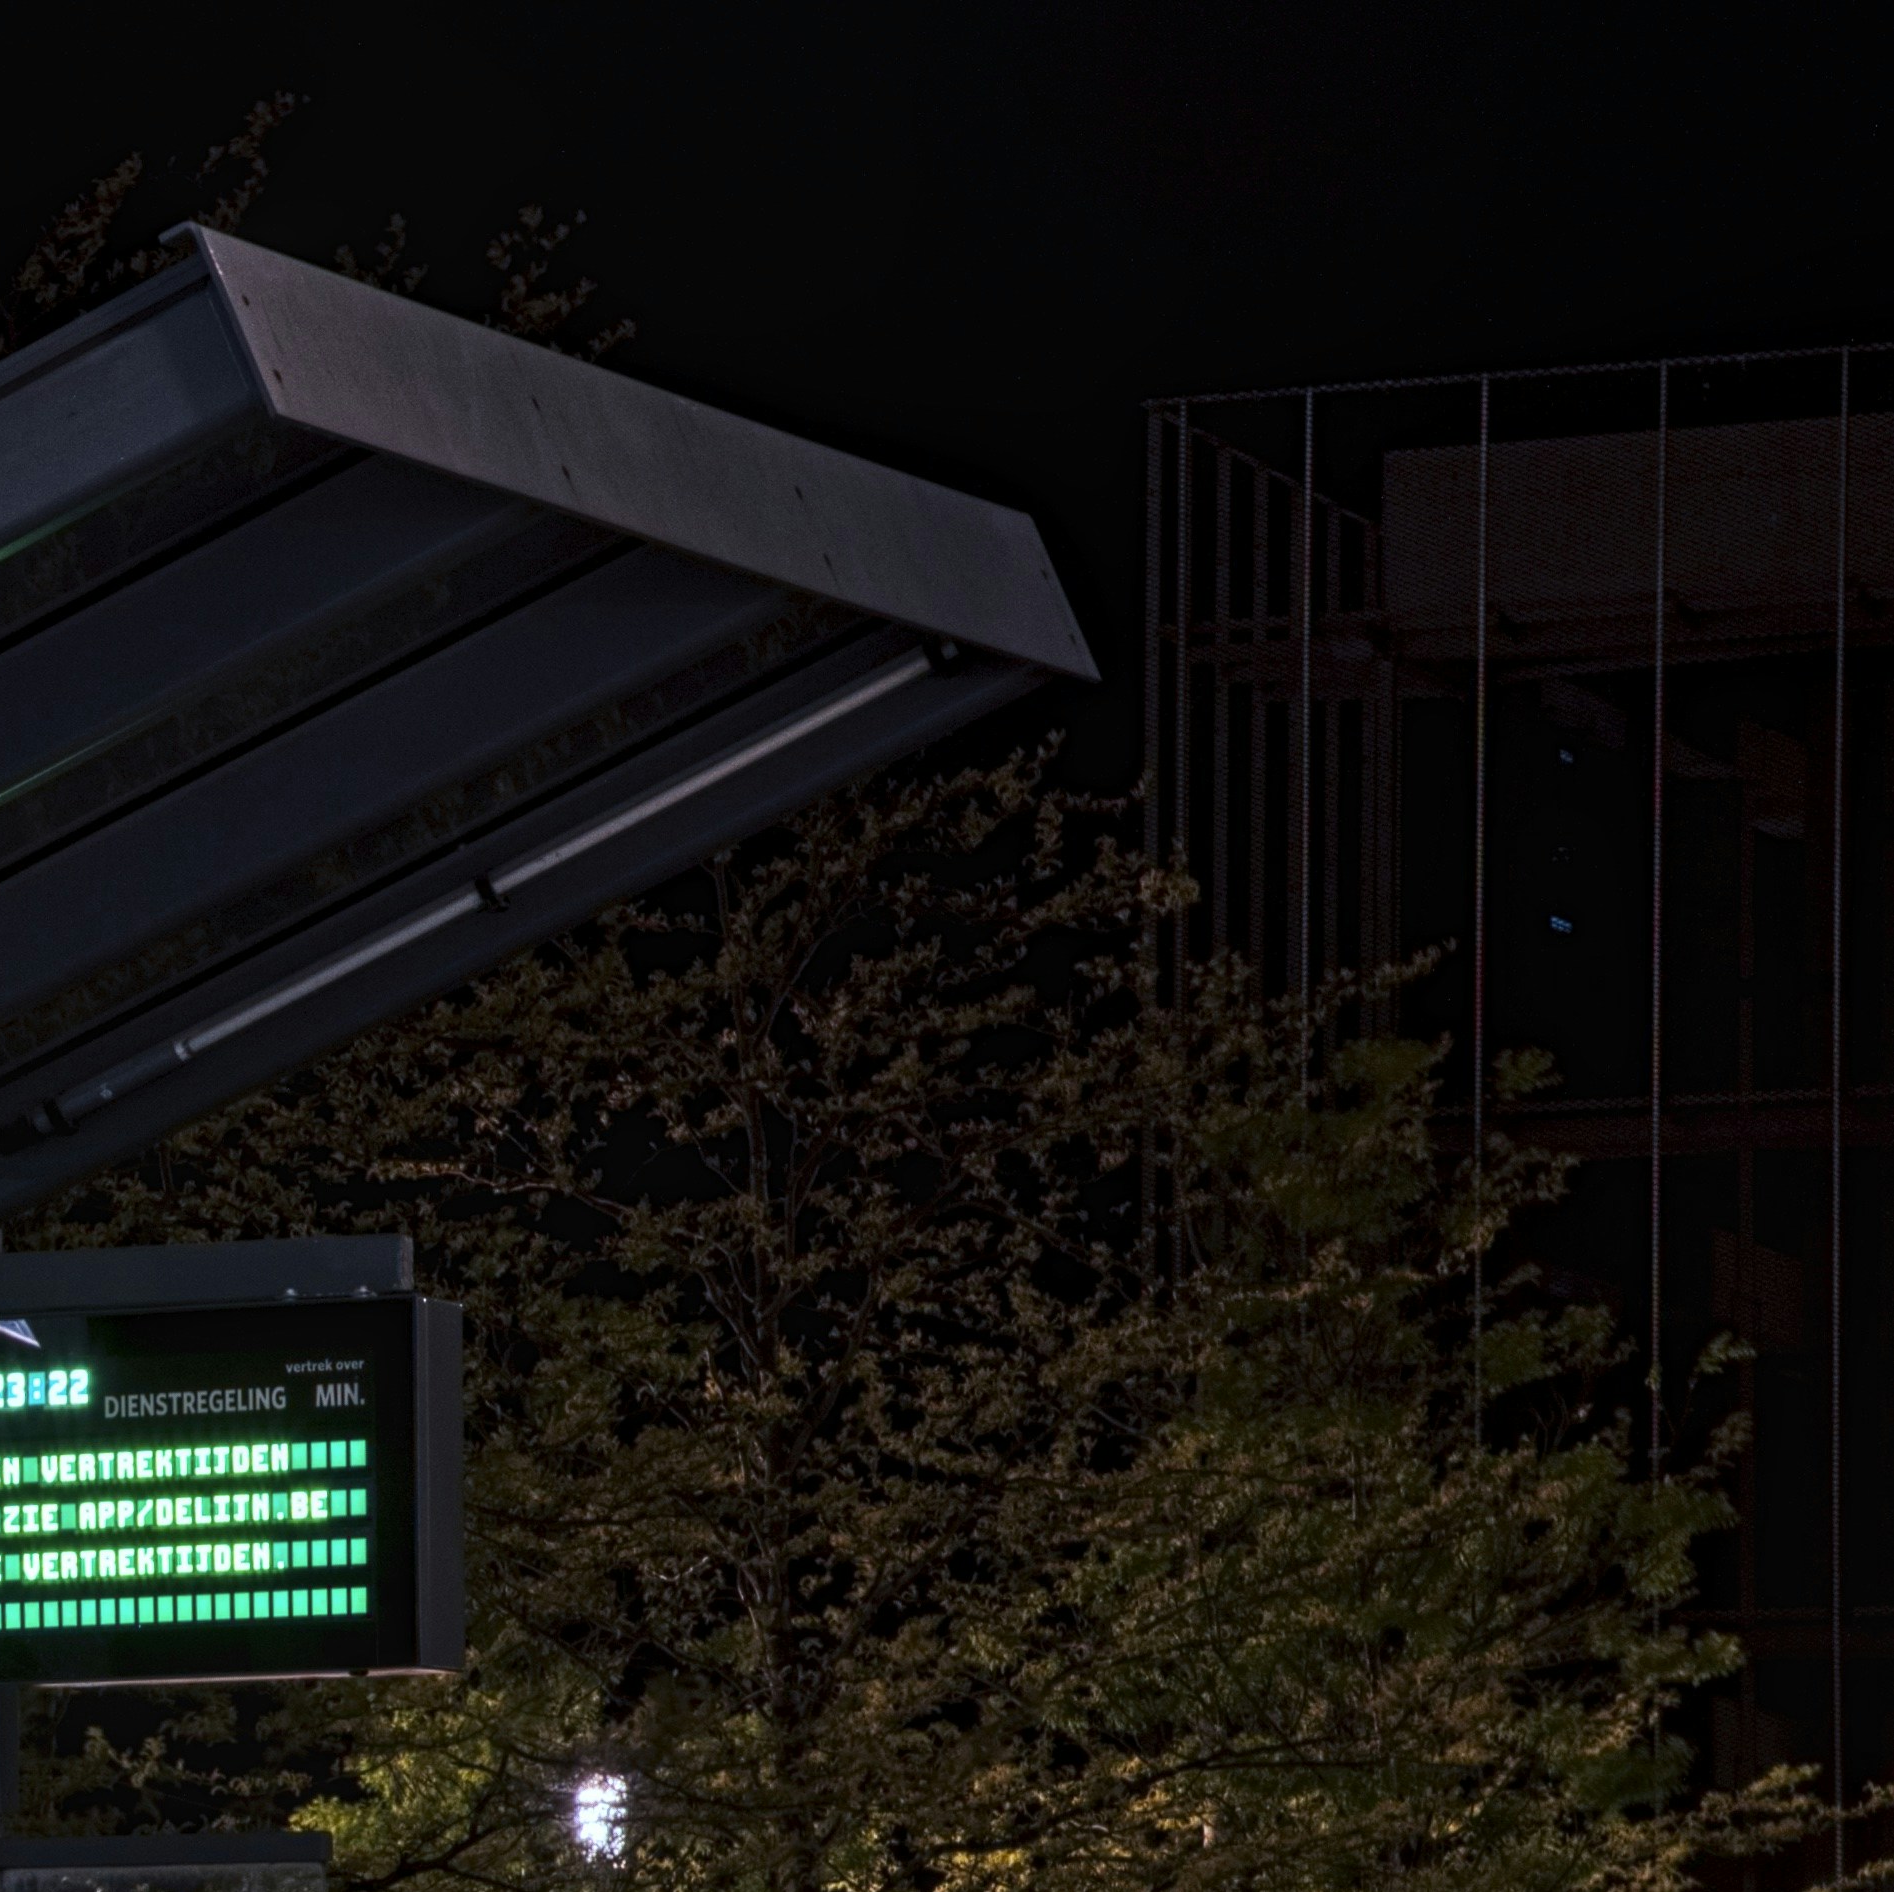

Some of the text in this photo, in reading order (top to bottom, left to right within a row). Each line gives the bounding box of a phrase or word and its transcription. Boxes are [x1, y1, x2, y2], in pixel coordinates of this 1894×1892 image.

[285, 1359, 365, 1374] vertrek over
[104, 1386, 286, 1419] DIENSTREGELING
[315, 1382, 365, 1408] MIN.
[40, 1443, 289, 1483] VERTREKTIJDEN
[3, 1503, 59, 1533] ZIE
[23, 1541, 285, 1581] VERTREKTIJDEN.
